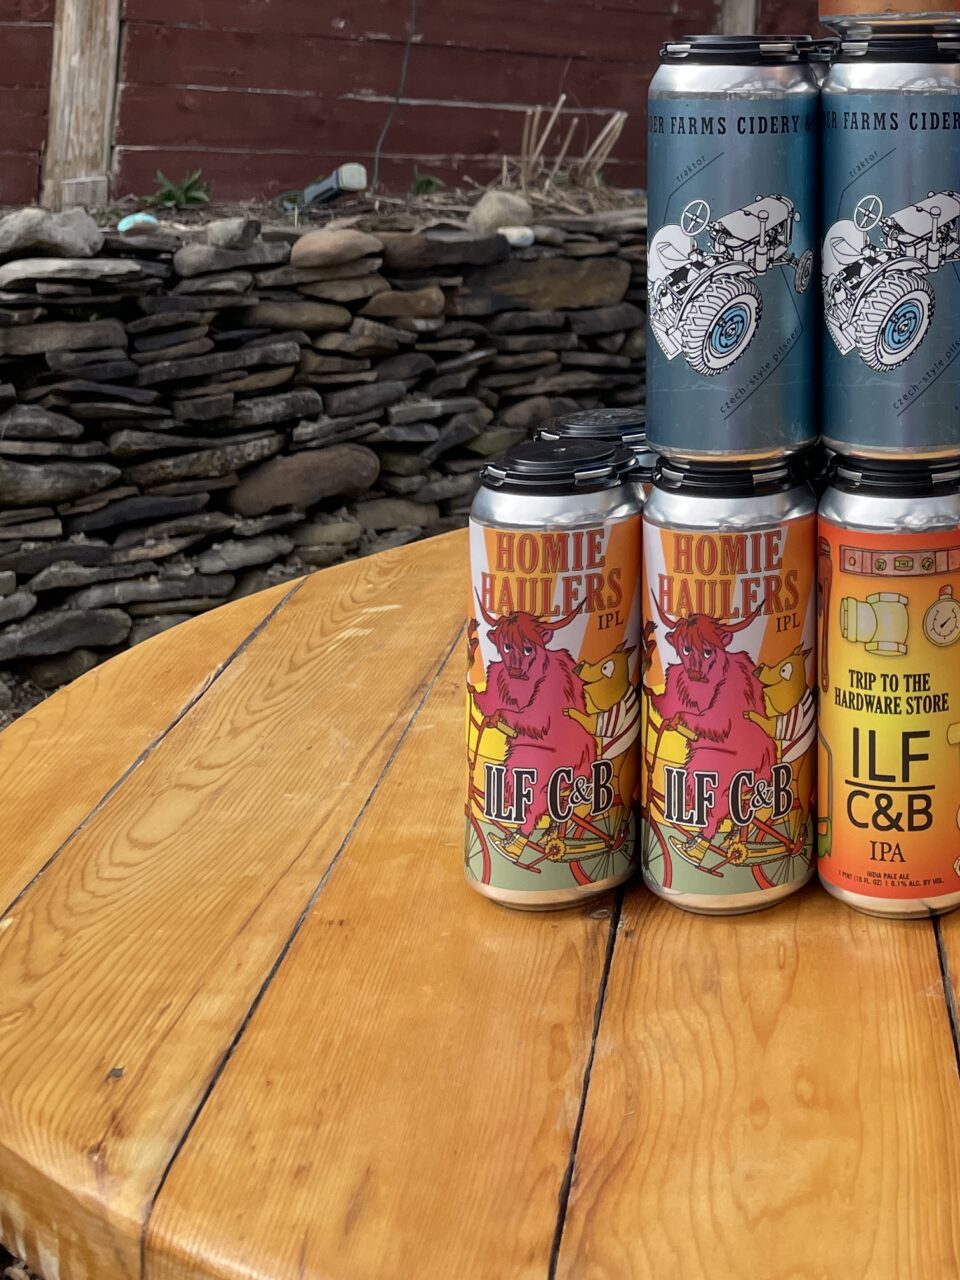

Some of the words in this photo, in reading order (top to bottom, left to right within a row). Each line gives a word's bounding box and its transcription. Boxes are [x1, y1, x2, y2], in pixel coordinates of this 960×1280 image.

[670, 116, 726, 135] FARMS
[737, 116, 799, 134] CIDERY
[843, 112, 898, 131] FARMS
[676, 155, 706, 182] traktor
[849, 151, 879, 178] traktor
[720, 362, 770, 413] czech-style
[893, 359, 944, 409] czech-style
[495, 529, 606, 574] HOMIE
[673, 529, 783, 575] HOMIE
[480, 567, 623, 619] HAULERS
[658, 570, 800, 620] HAULERS
[597, 611, 624, 632] IPL
[775, 612, 801, 634] IPL
[834, 687, 902, 715] HARDWARE
[906, 692, 949, 715] STORE
[848, 669, 876, 691] TRIP
[880, 673, 899, 693] TO
[903, 673, 931, 693] THE
[851, 726, 931, 783] ILF
[484, 762, 537, 823] ILF
[547, 759, 614, 822] C&B
[664, 766, 719, 827] ILF
[729, 763, 794, 826] C&B
[845, 789, 934, 833] C&B
[869, 840, 906, 863] IPA
